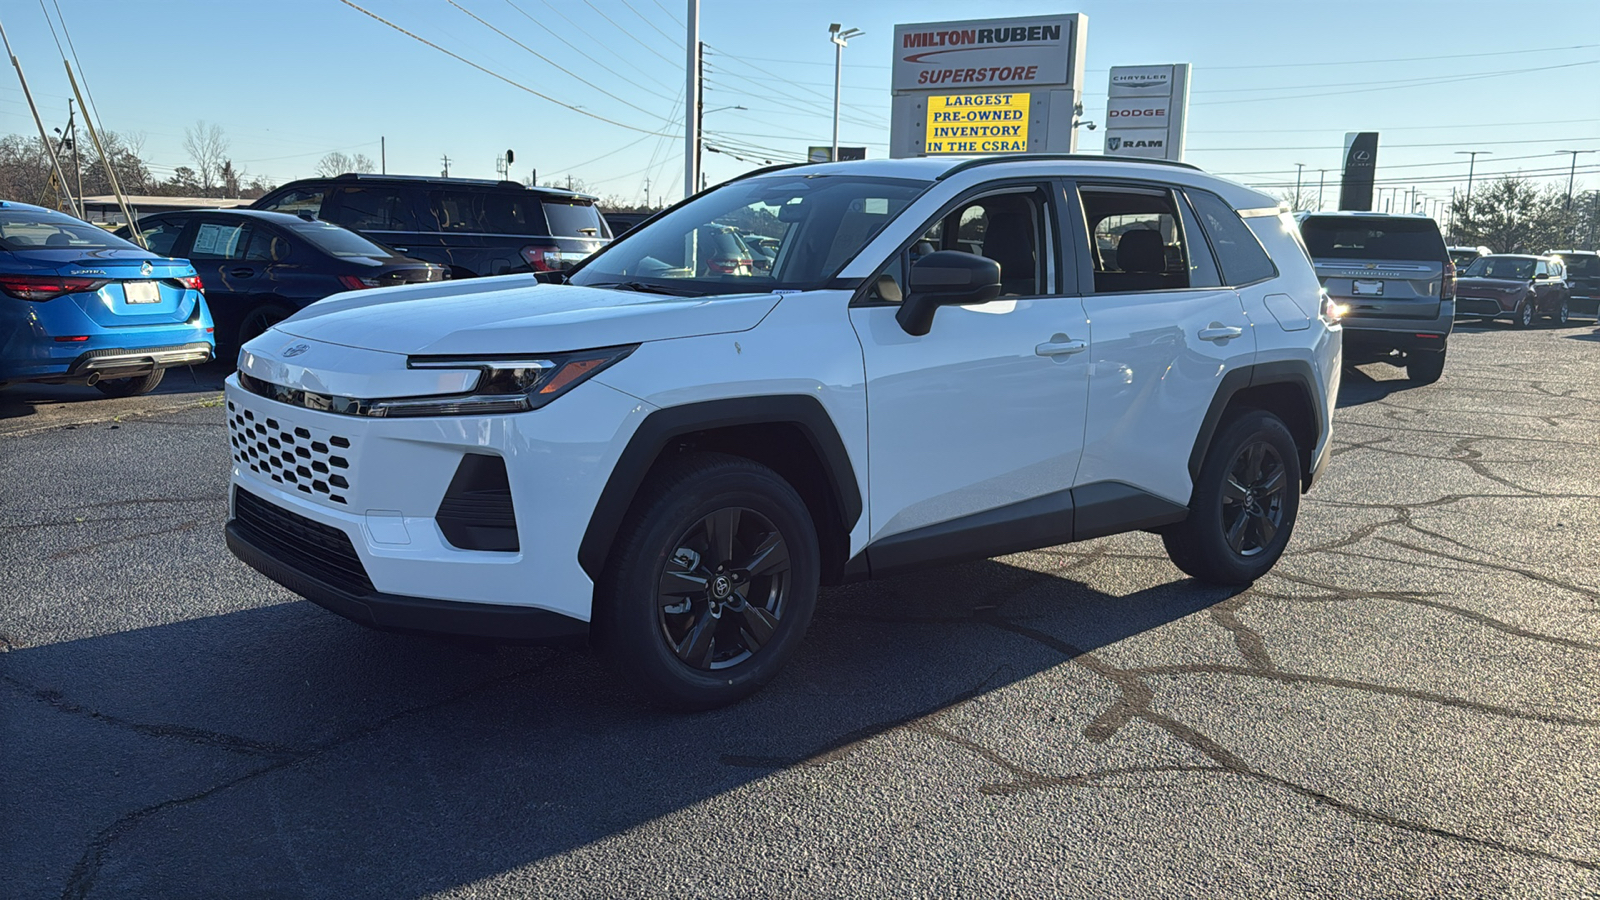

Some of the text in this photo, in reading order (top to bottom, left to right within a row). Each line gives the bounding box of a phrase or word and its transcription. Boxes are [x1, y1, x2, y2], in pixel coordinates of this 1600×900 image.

[917, 66, 1038, 84] SUPERSTORE
[945, 95, 1013, 106] LARGEST
[934, 110, 1023, 121] PRE-OWNED
[1109, 109, 1165, 117] DODGE
[934, 125, 1021, 136] INVENTORY
[927, 141, 1026, 151] IN THE CSRA!
[1123, 140, 1163, 148] RAM
